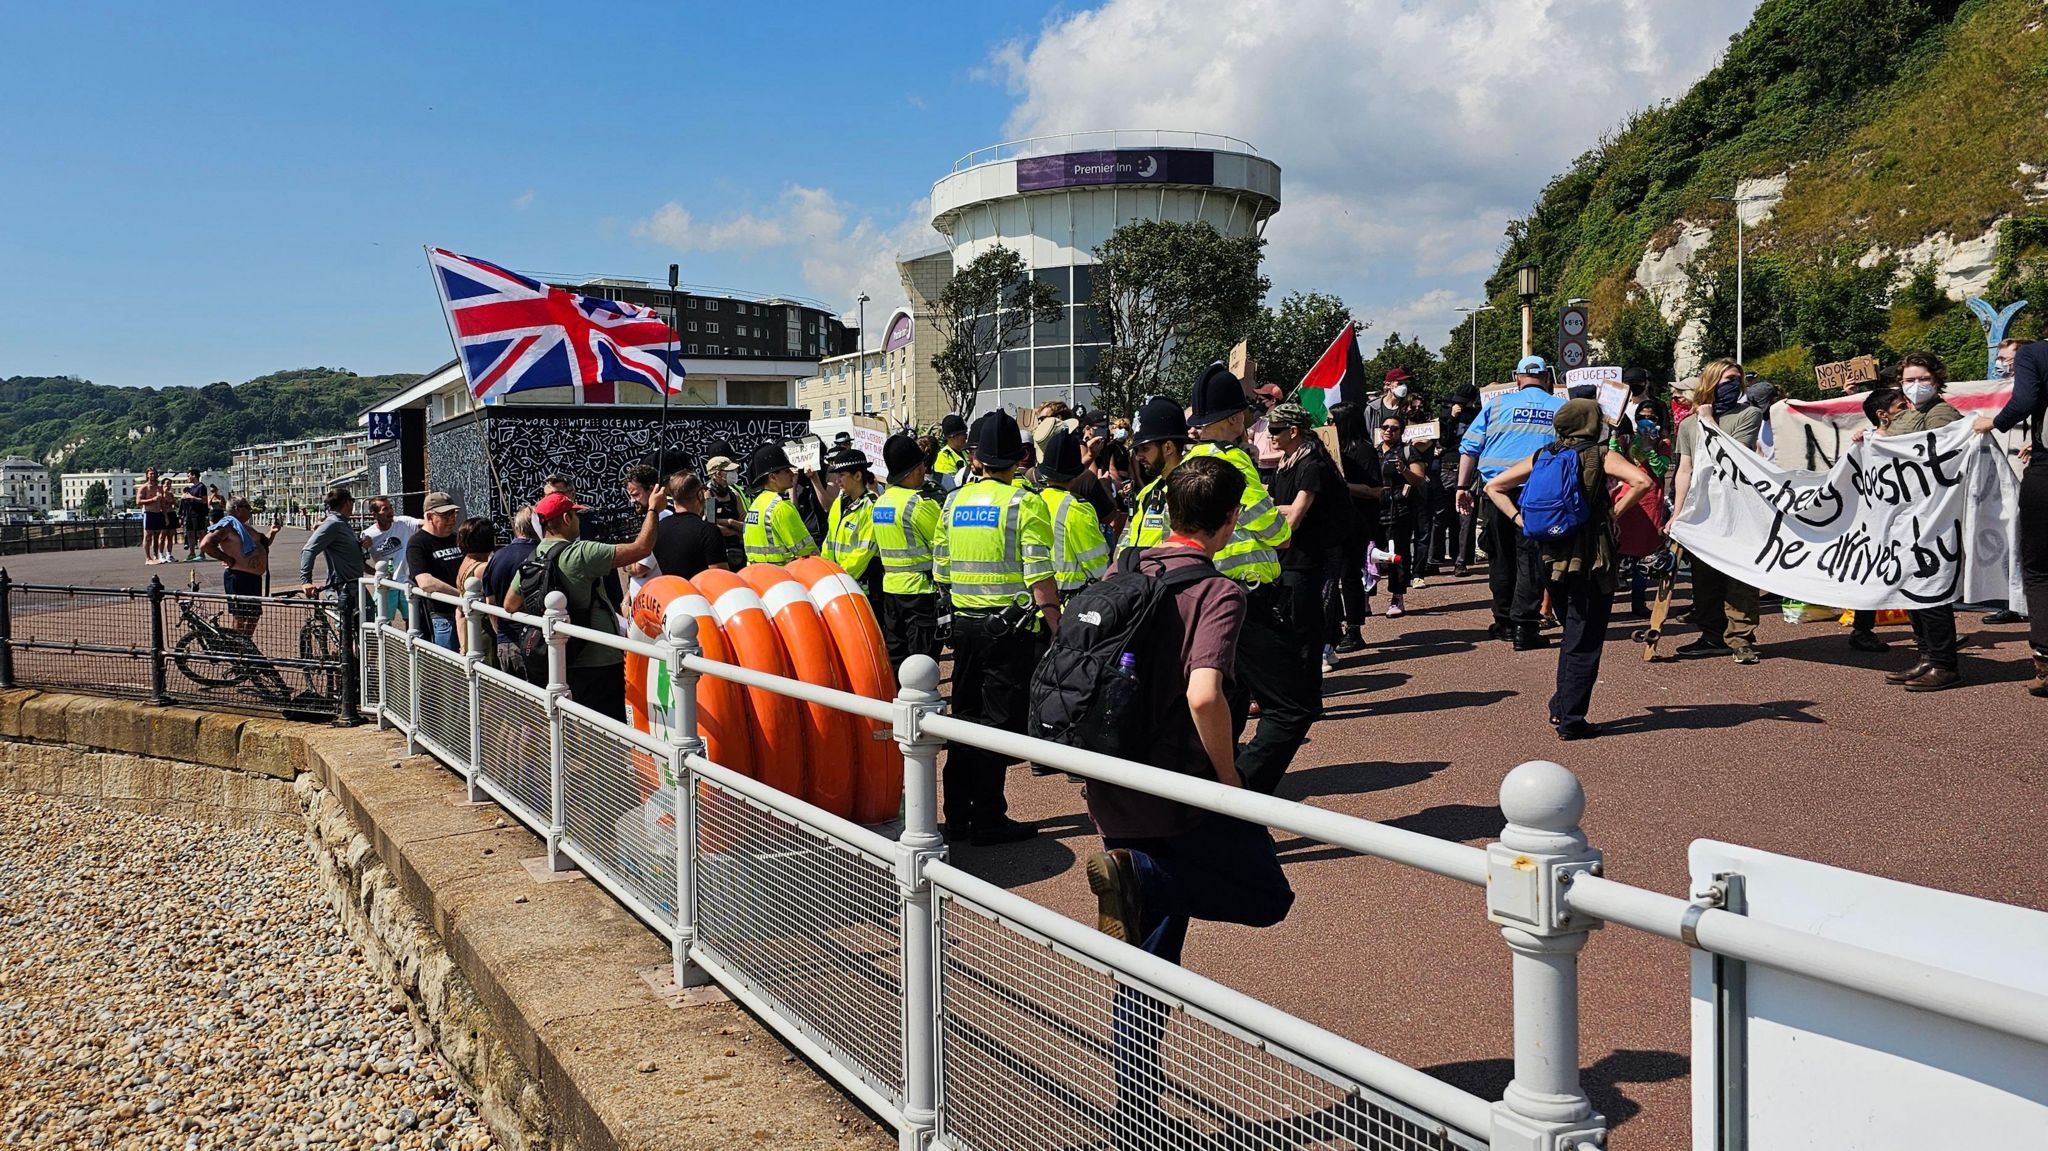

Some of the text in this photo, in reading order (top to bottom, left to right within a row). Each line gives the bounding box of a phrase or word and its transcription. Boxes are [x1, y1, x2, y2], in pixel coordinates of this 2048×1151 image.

[1074, 162, 1132, 175] Premier Inn
[1817, 360, 1852, 379] NO ONE
[1568, 369, 1618, 383] REFUGEES
[1828, 377, 1837, 388] IS
[1514, 408, 1554, 420] POLICE
[524, 418, 559, 428] WORLD
[568, 418, 591, 427] WITH
[602, 418, 644, 428] OCEANS
[690, 419, 702, 428] OF
[1403, 426, 1433, 438] RACISM
[1847, 431, 1964, 509] doesn't
[576, 477, 591, 489] ON
[873, 510, 894, 520] POLICE
[955, 510, 997, 522] POLICE
[1755, 509, 1811, 572] he
[1900, 515, 1962, 603] by
[647, 594, 661, 620] LIFE
